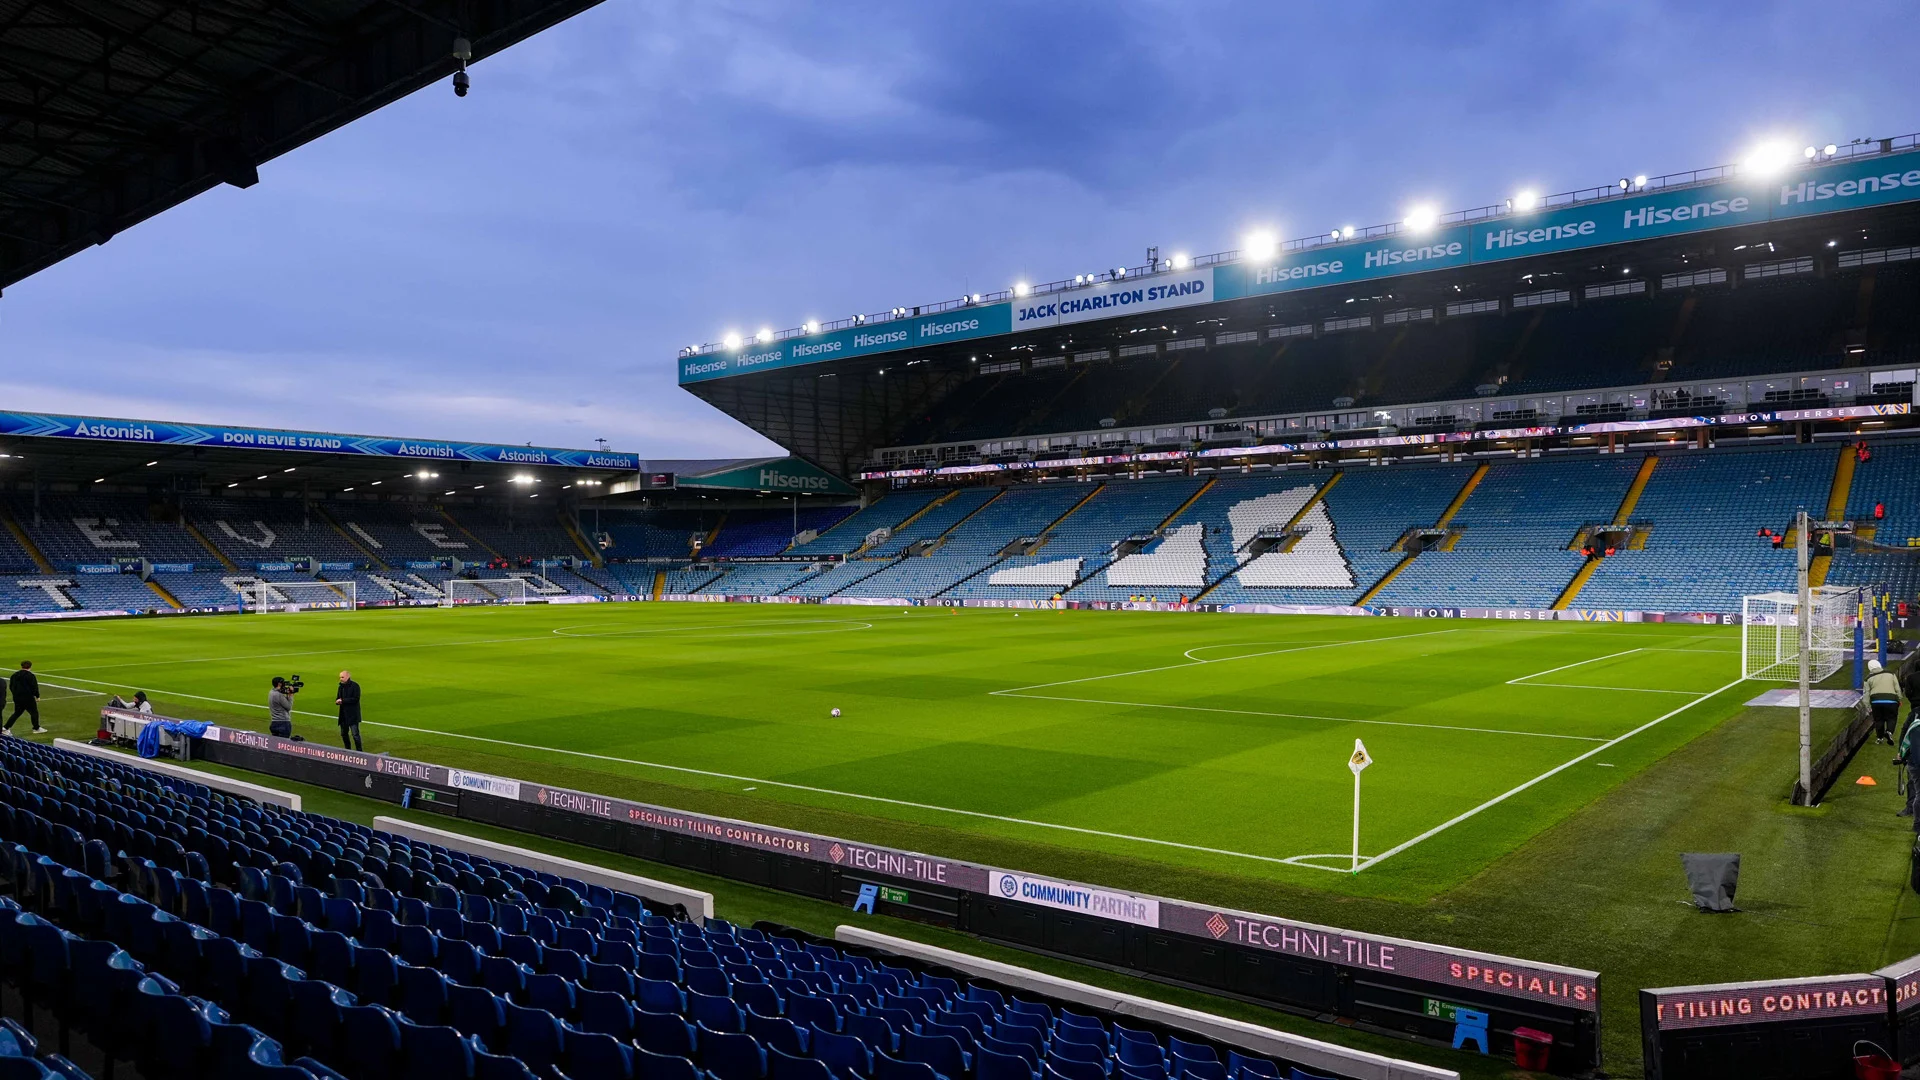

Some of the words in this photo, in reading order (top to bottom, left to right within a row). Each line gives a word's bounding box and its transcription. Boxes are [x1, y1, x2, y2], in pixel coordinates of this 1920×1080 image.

[1623, 197, 1749, 229] Hisense
[1485, 220, 1596, 250] Hisense
[1364, 241, 1462, 269] Hisense
[1256, 260, 1344, 285] Hisense
[1019, 303, 1058, 322] JACK
[1060, 289, 1144, 315] CHARLTON
[1147, 279, 1205, 300] STAND
[920, 317, 979, 338] Hisense
[853, 328, 907, 348] Hisense
[736, 349, 782, 367] Hisense
[792, 339, 842, 358] Hisense
[684, 358, 727, 376] Hisense
[1738, 411, 1783, 422] HOME
[1794, 408, 1857, 419] JERSEY
[74, 420, 155, 440] Astonish
[223, 432, 254, 444] DON
[257, 434, 296, 446] REVIE
[298, 437, 342, 449] STAND
[398, 442, 454, 458] Astonish
[1312, 441, 1342, 449] HOME
[1350, 438, 1392, 447] JERSEY
[498, 448, 548, 463] Astonish
[586, 453, 631, 467] Astonish
[760, 469, 829, 489] Hisense
[80, 565, 117, 574] Astonish
[936, 599, 968, 608] HOME
[976, 600, 1021, 609] JERSEY
[1346, 607, 1400, 617] 24/25
[1414, 608, 1467, 619] HOME
[235, 732, 269, 749] TECHNI-TILE
[277, 742, 306, 754] SPECIALIST
[326, 752, 368, 766] CONTRACTORS
[384, 759, 430, 780] TECHNI-TILE
[462, 775, 492, 791] COMMUNITY
[492, 781, 516, 795] PARTNER
[549, 791, 611, 816] TECHNI-TILE
[629, 809, 684, 828] SPECIALIST
[688, 820, 722, 836] TILING
[726, 829, 811, 852] CONTRACTORS
[847, 847, 947, 883] TECHNI-TILE
[1022, 881, 1091, 909] COMMUNITY
[1092, 893, 1147, 920] PARTNER
[1235, 918, 1396, 970] TECHNI-TILE
[1450, 962, 1596, 1001] SPECIALIS
[1675, 998, 1751, 1019] TILING
